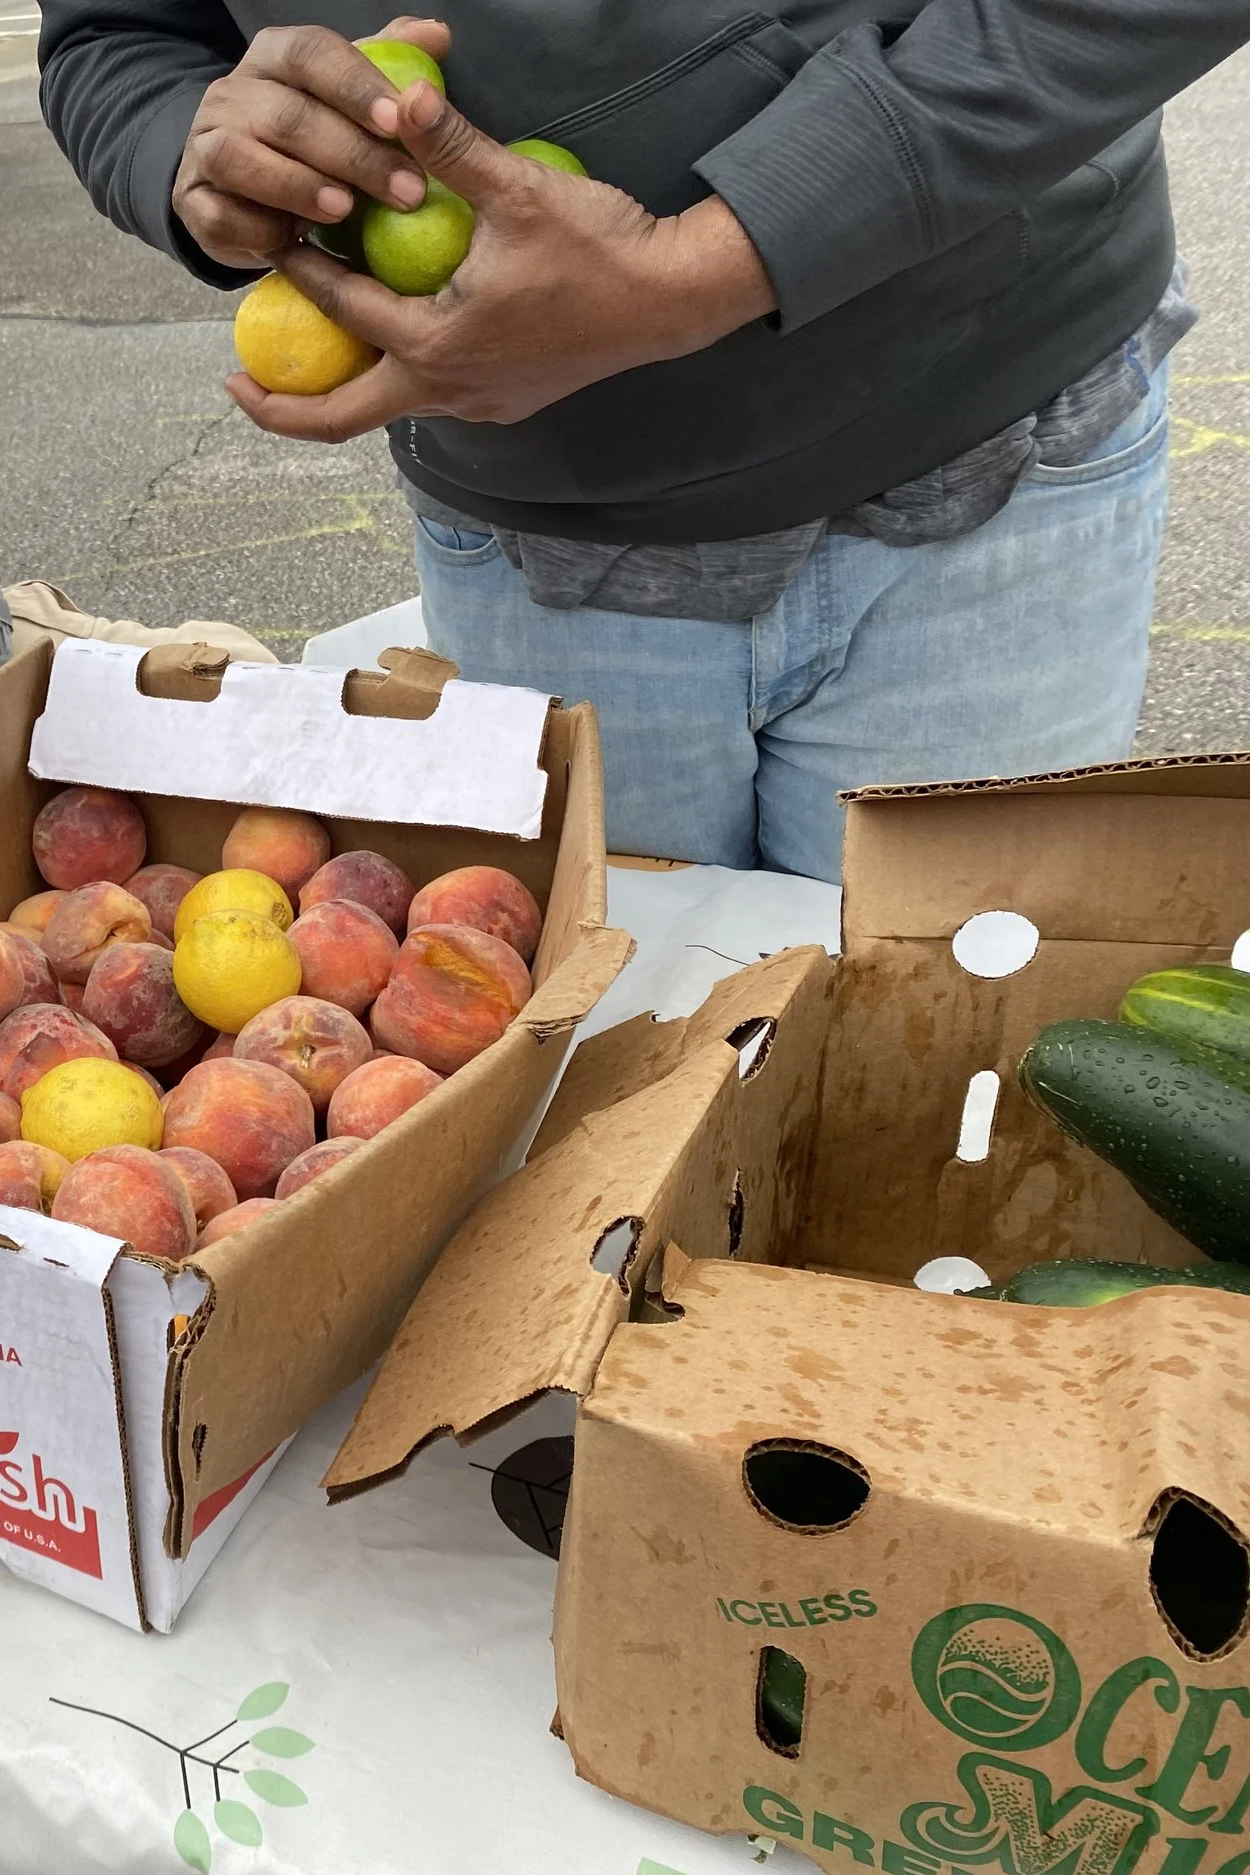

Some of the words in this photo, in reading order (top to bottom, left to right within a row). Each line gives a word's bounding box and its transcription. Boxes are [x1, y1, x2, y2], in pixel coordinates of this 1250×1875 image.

[3, 1520, 21, 1534] OF
[24, 1528, 62, 1552] U.S.A.
[716, 1589, 878, 1628] ICELESS
